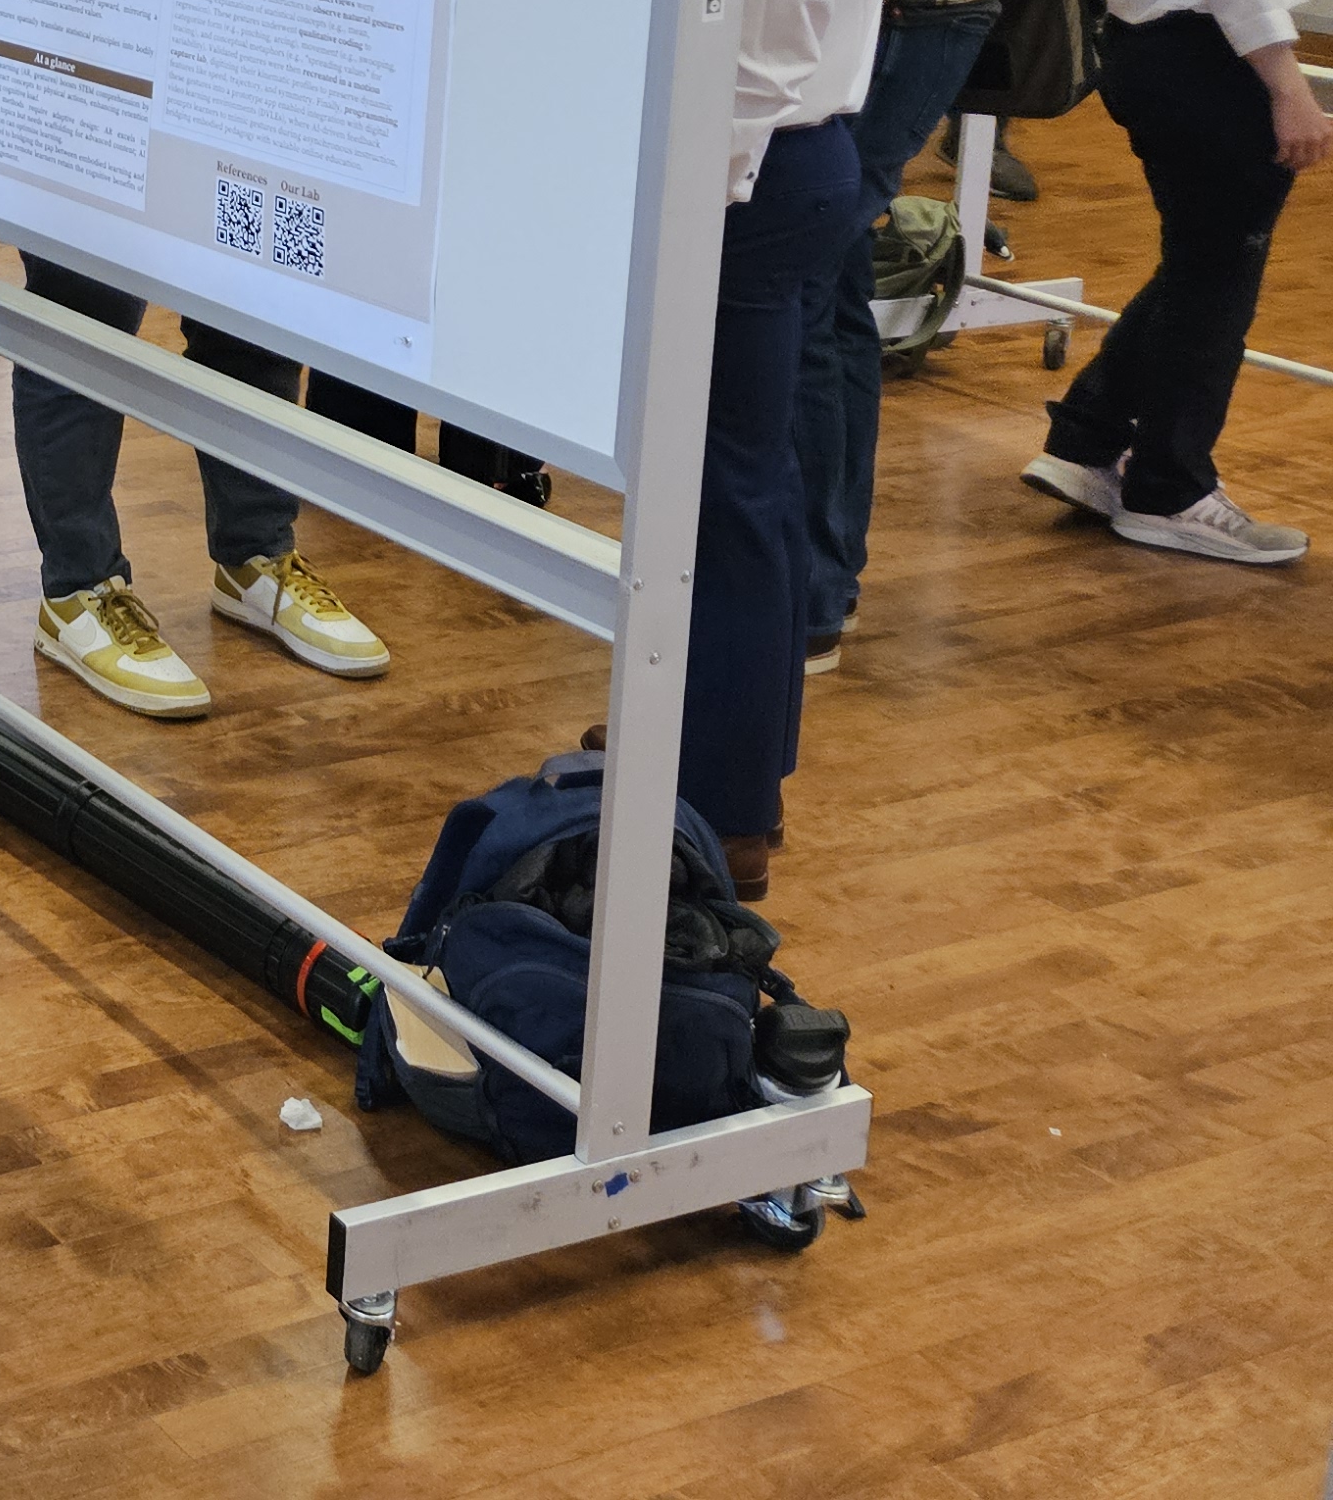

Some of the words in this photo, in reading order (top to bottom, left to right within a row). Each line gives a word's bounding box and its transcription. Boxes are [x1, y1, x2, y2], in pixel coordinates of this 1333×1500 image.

[33, 52, 43, 64] At
[44, 56, 49, 66] a
[50, 56, 75, 72] glance
[217, 160, 268, 185] References
[281, 180, 300, 195] Our
[301, 186, 320, 202] Lab
